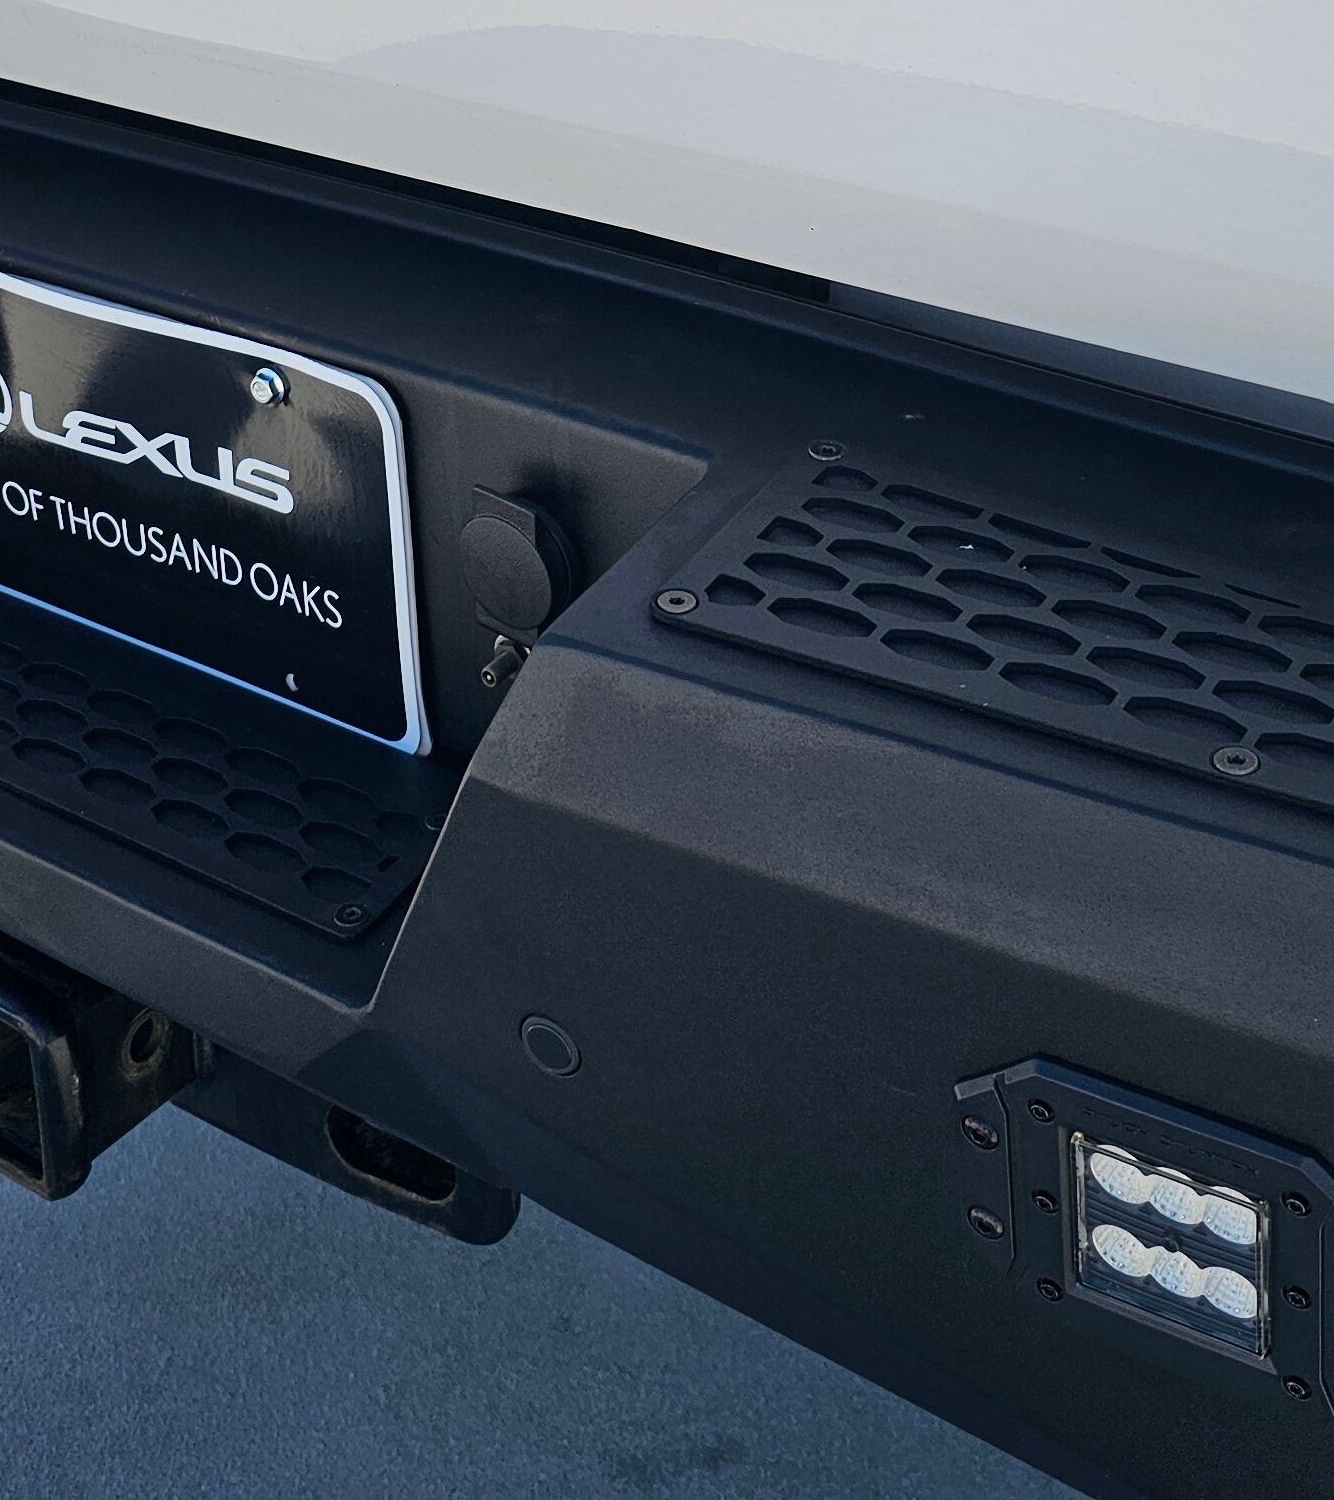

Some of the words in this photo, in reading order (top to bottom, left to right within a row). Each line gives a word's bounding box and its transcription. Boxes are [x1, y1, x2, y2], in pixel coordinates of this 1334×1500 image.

[19, 390, 294, 515] LEXUS
[1, 478, 44, 522] OF
[49, 494, 243, 587] THOUSAND
[248, 560, 344, 630] OAKS
